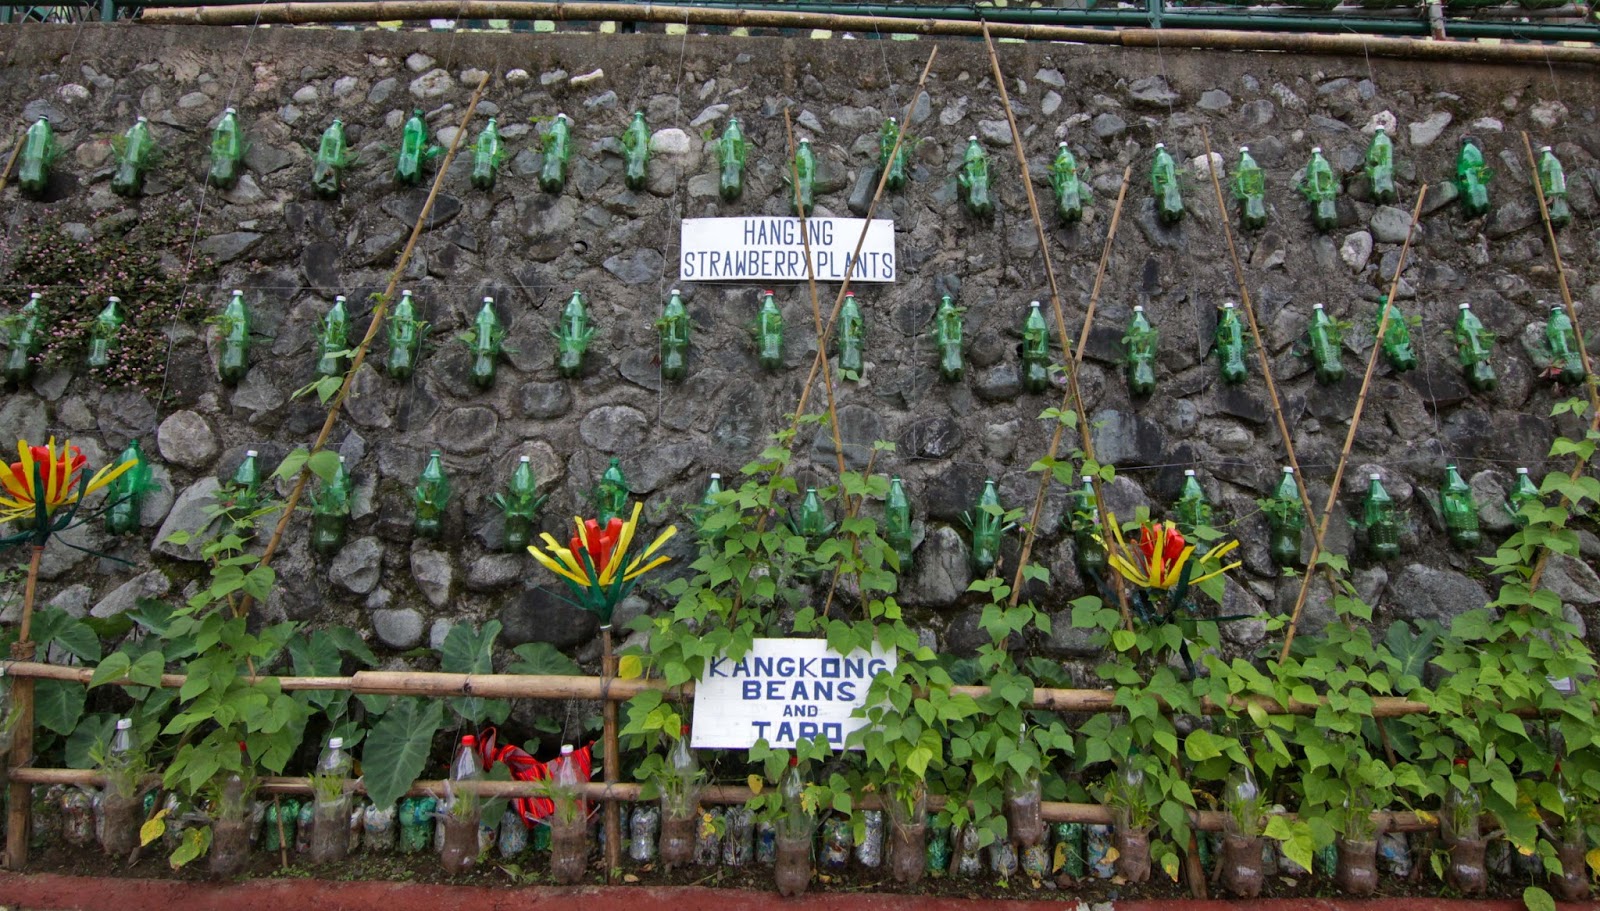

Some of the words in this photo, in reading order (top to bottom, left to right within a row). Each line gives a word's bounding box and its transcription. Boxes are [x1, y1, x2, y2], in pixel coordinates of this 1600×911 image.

[744, 219, 833, 245] HANGING
[684, 250, 811, 277] STRAWBERRY
[817, 252, 893, 279] PLANTS
[709, 656, 887, 679] KANGKONG
[742, 680, 856, 701] BEANS
[783, 704, 818, 718] AND
[752, 721, 842, 743] TARO
